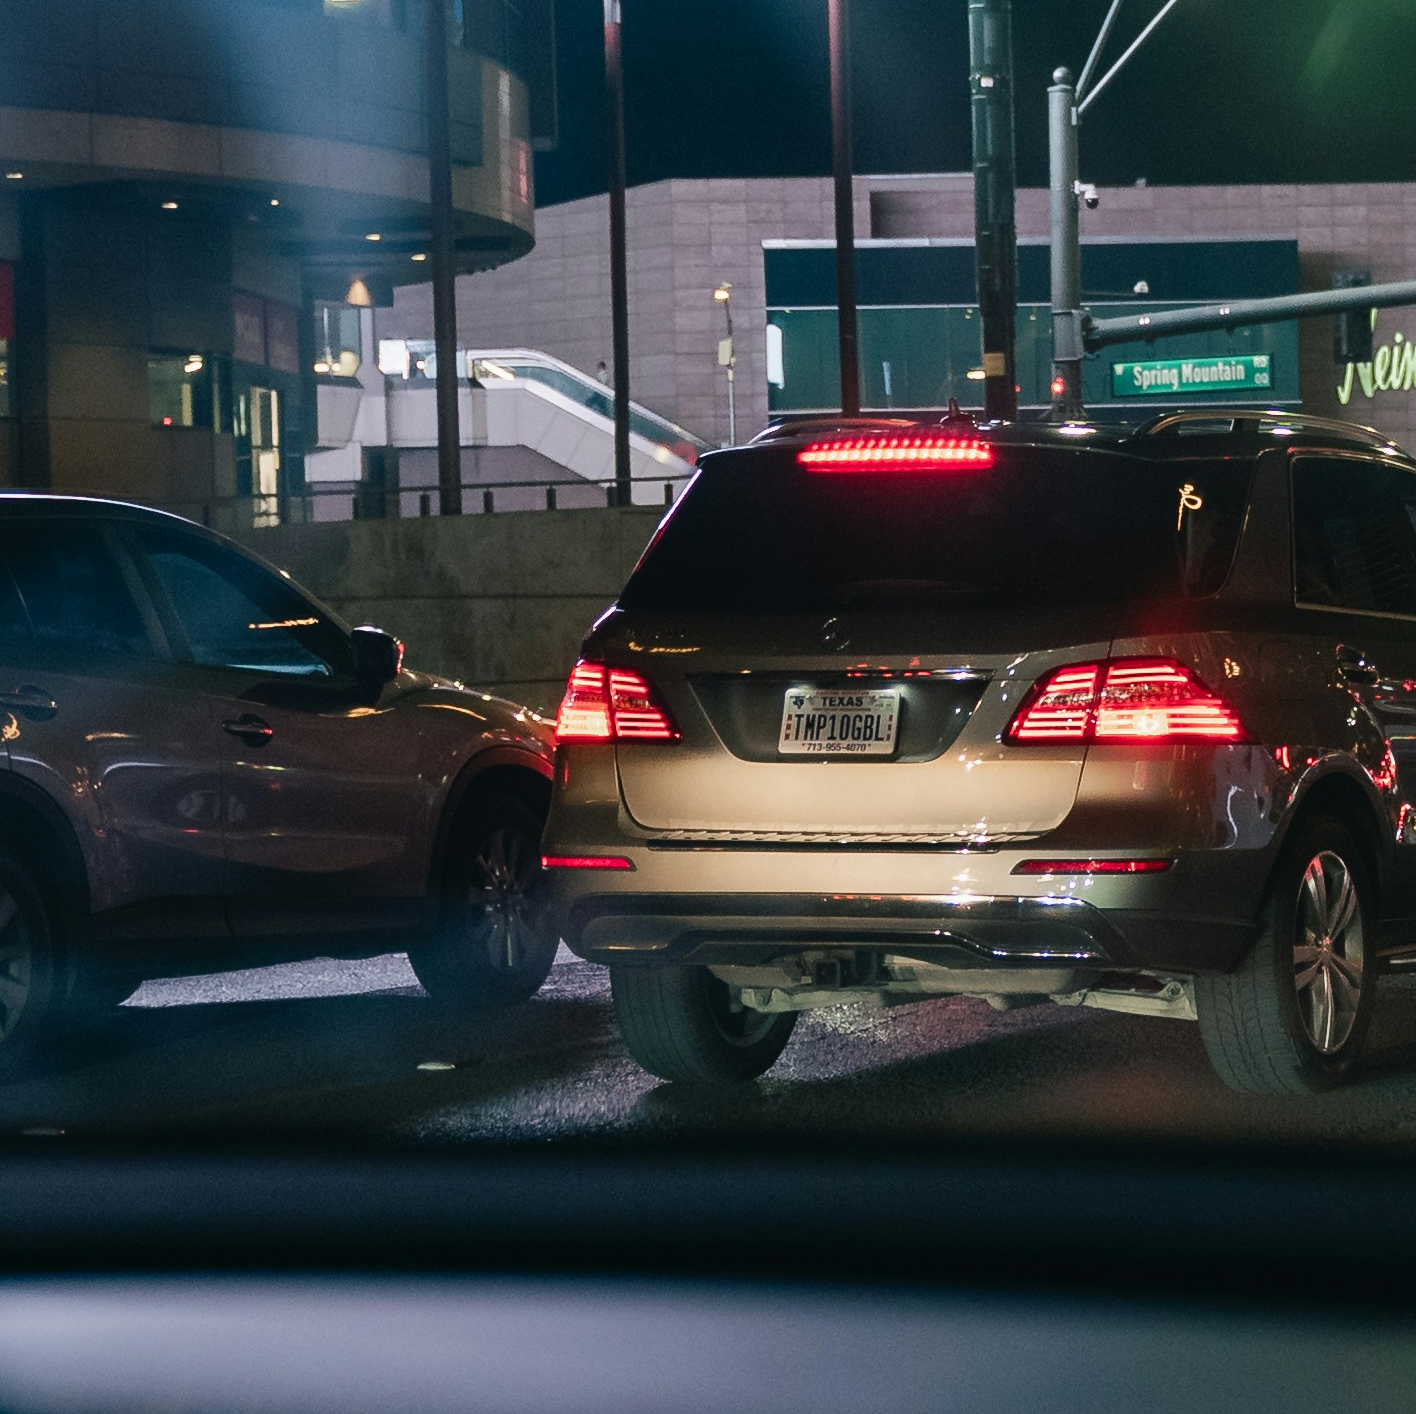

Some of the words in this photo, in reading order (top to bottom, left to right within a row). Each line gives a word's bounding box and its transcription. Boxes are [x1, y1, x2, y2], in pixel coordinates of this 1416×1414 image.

[1133, 365, 1179, 390] Spring
[1181, 361, 1246, 383] Mountain
[821, 696, 864, 708] TEXAS
[794, 713, 885, 741] TMP10GBL
